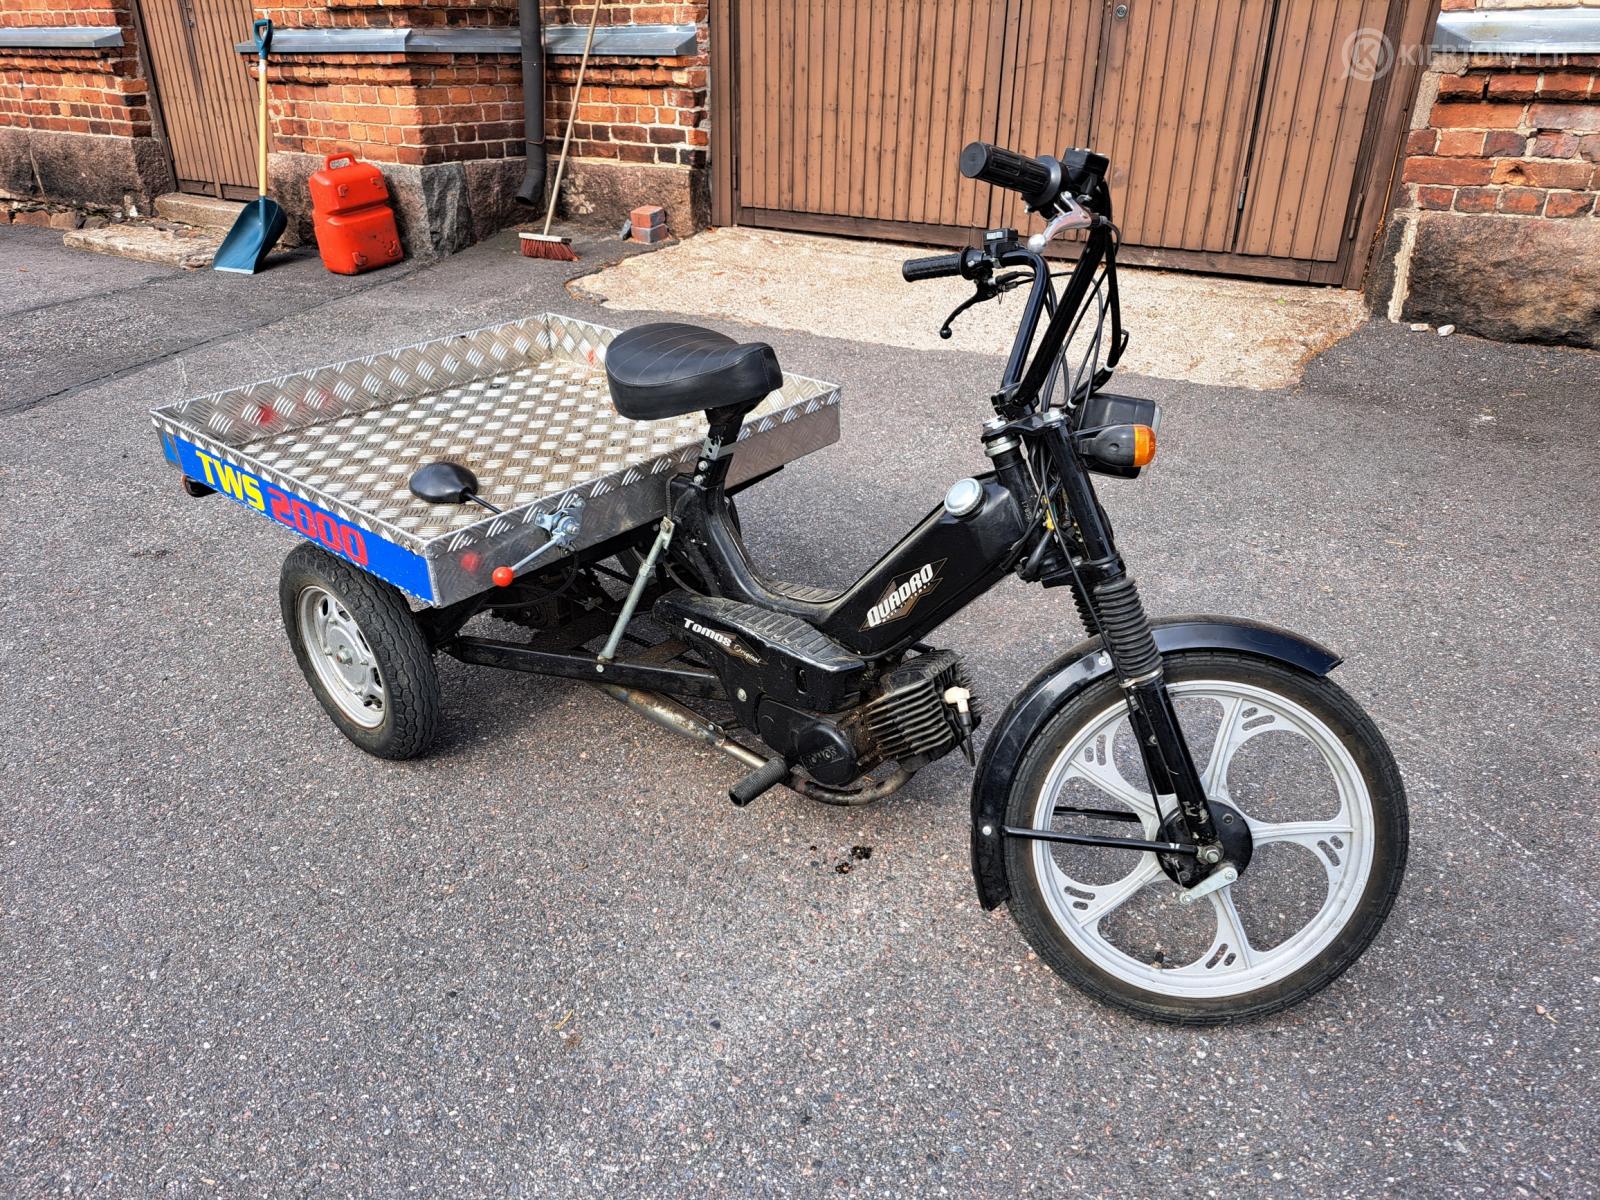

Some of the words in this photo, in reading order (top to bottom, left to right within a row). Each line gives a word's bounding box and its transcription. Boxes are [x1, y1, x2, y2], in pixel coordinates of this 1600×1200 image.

[195, 449, 265, 511] TWS
[267, 486, 369, 566] 2000
[866, 563, 934, 628] QUADRO
